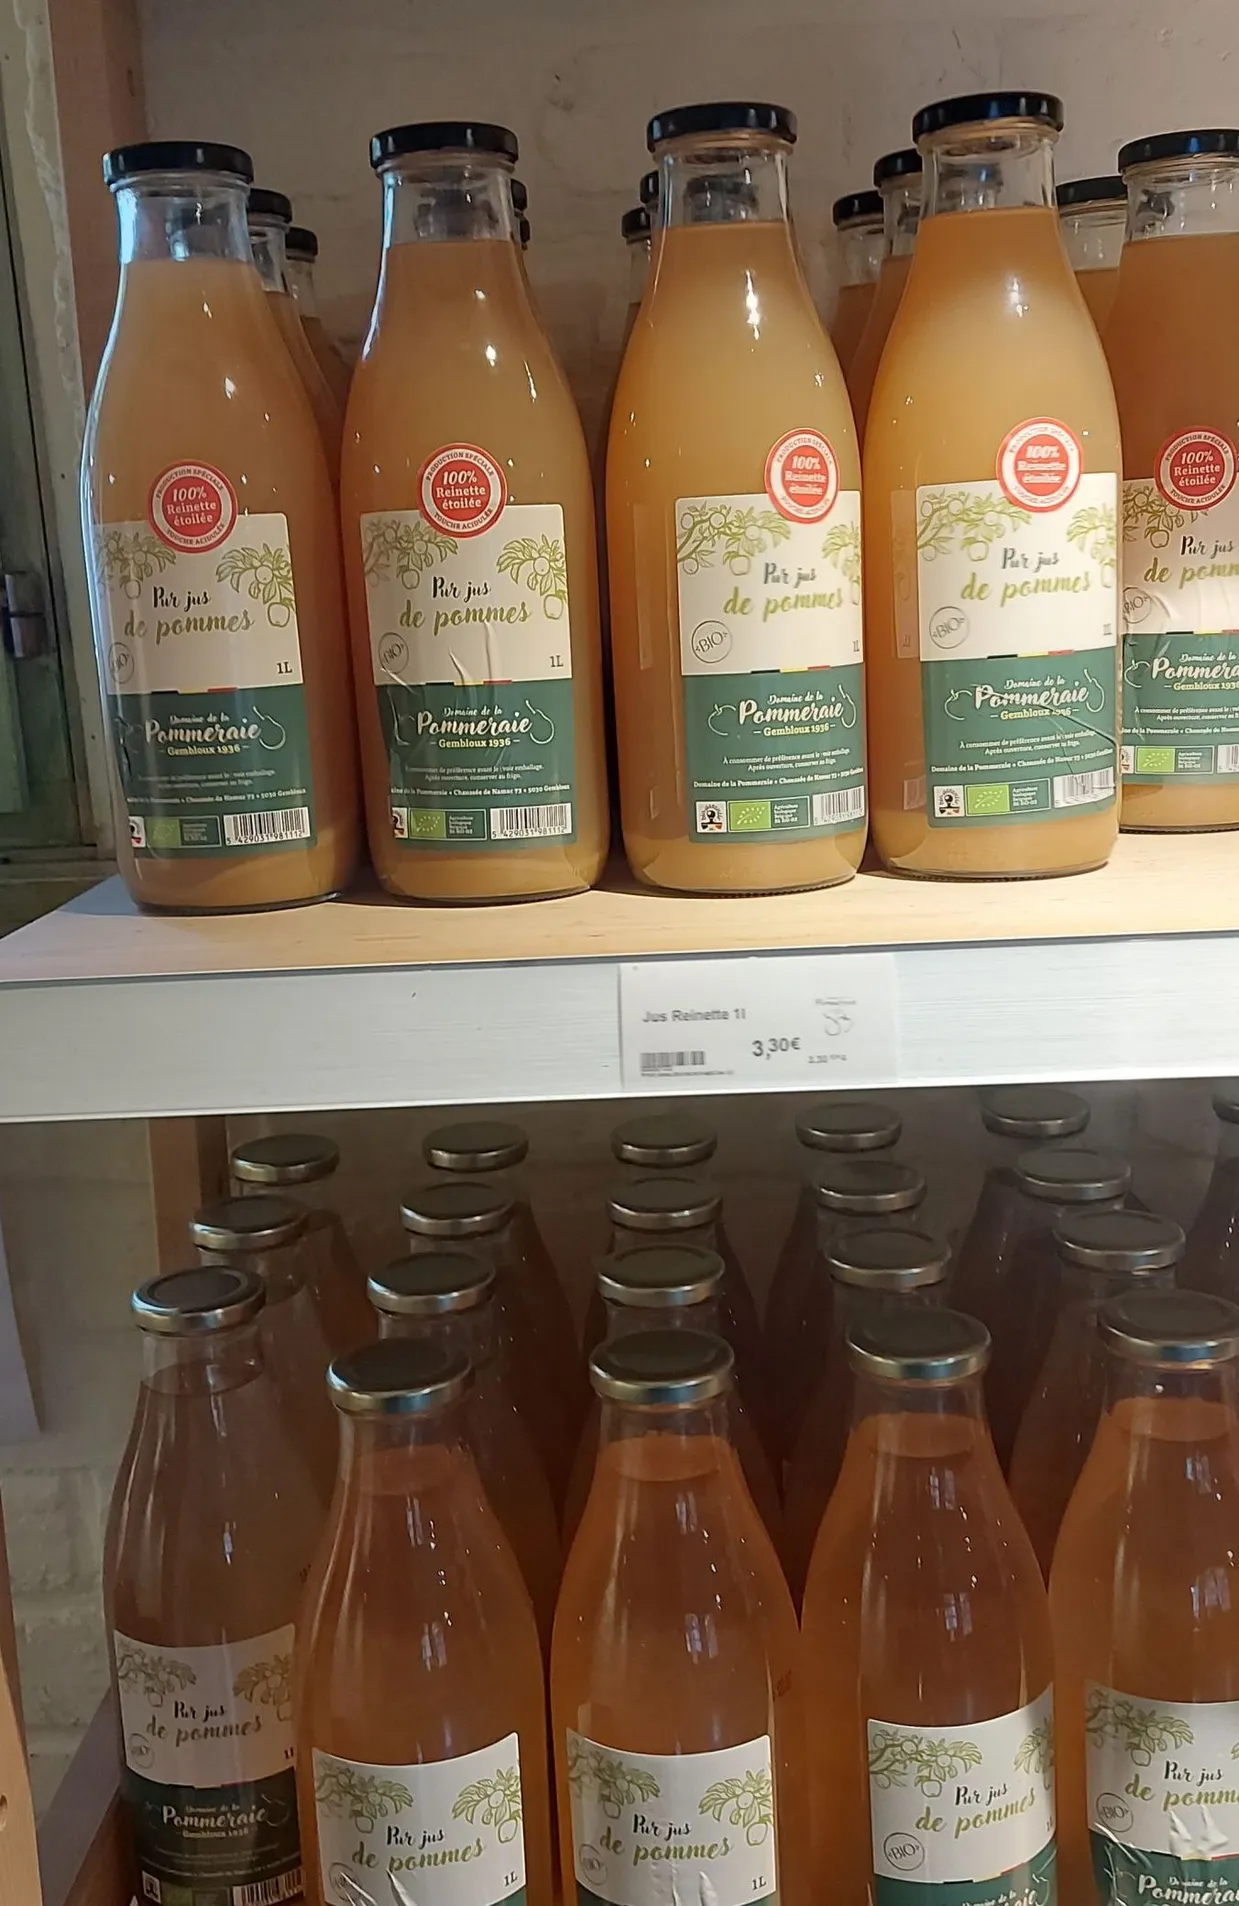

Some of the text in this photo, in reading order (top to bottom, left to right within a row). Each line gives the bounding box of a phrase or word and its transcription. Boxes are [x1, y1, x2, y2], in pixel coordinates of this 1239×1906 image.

[1165, 434, 1202, 462] PRODUCTION
[1181, 450, 1214, 465] 100%
[426, 452, 495, 481] PRODUCTION SPÉCIALE
[792, 456, 821, 470] 100%
[1174, 464, 1221, 477] Reinette
[443, 470, 477, 485] 100%
[1178, 475, 1217, 488] étoilée
[172, 486, 207, 502] 100%
[436, 486, 486, 499] Reinette
[1170, 484, 1227, 505] TOUCHE ACIDULÉE
[166, 501, 217, 515] Reinette
[442, 498, 482, 511] étoilée
[174, 513, 214, 527] étoilée
[433, 508, 493, 530] TOUCHE ACIDULÉE
[1180, 536, 1236, 559] Pur jus
[1002, 548, 1060, 573] Pur jus
[764, 563, 817, 589] Pur jus
[1144, 557, 1239, 590] de pomm
[153, 586, 211, 612] Pur jus
[432, 576, 492, 603] Pur jus
[961, 572, 1091, 608] de pommes
[723, 586, 844, 622] de pommes
[124, 610, 255, 646] de pommes
[400, 600, 532, 636] de pommes
[936, 617, 961, 639] BIO
[698, 632, 724, 653] BIO
[277, 662, 293, 674] 1L
[550, 656, 564, 668] 1L
[1179, 651, 1237, 663] Domaine de la
[1152, 656, 1239, 681] Pommera
[1004, 675, 1065, 690] Domaine de la
[1173, 682, 1220, 691] Gembloux
[768, 690, 824, 705] Domaine de la
[974, 681, 1089, 710] Pommeraie
[208, 713, 218, 723] de
[220, 712, 230, 722] la
[444, 706, 502, 717] Domaine de la
[739, 696, 844, 725] Pommeraie
[1000, 708, 1050, 721] Gembloux
[145, 718, 261, 744] Pommeraie
[417, 711, 533, 736] Pommeraie
[764, 724, 830, 737] Gembloux 1936
[168, 744, 241, 756] Gembloux 1936
[438, 738, 511, 749] Gembloux 1936
[958, 764, 966, 772] de
[226, 837, 232, 845] 5
[492, 830, 497, 838] 5
[642, 1010, 668, 1023] Jus
[672, 1008, 729, 1022] Reinette
[752, 1037, 801, 1060] 3,30€
[174, 1700, 226, 1722] Pur jus
[147, 1715, 262, 1748] de pommes
[1164, 1760, 1224, 1788] Pur jus
[955, 1783, 1008, 1807] Pur jus
[1125, 1773, 1239, 1812] de pomm
[162, 1804, 267, 1828] Pommeraie
[915, 1786, 1036, 1840] de pommes
[386, 1825, 445, 1850] Pur jus
[633, 1814, 691, 1842] Pur jus
[352, 1838, 486, 1873] de pommes
[600, 1826, 626, 1855] de
[633, 1837, 733, 1867] pommes
[890, 1843, 916, 1861] BIO
[504, 1872, 518, 1888] 1L
[752, 1875, 767, 1891] 1L
[1138, 1874, 1239, 1905] Pommera
